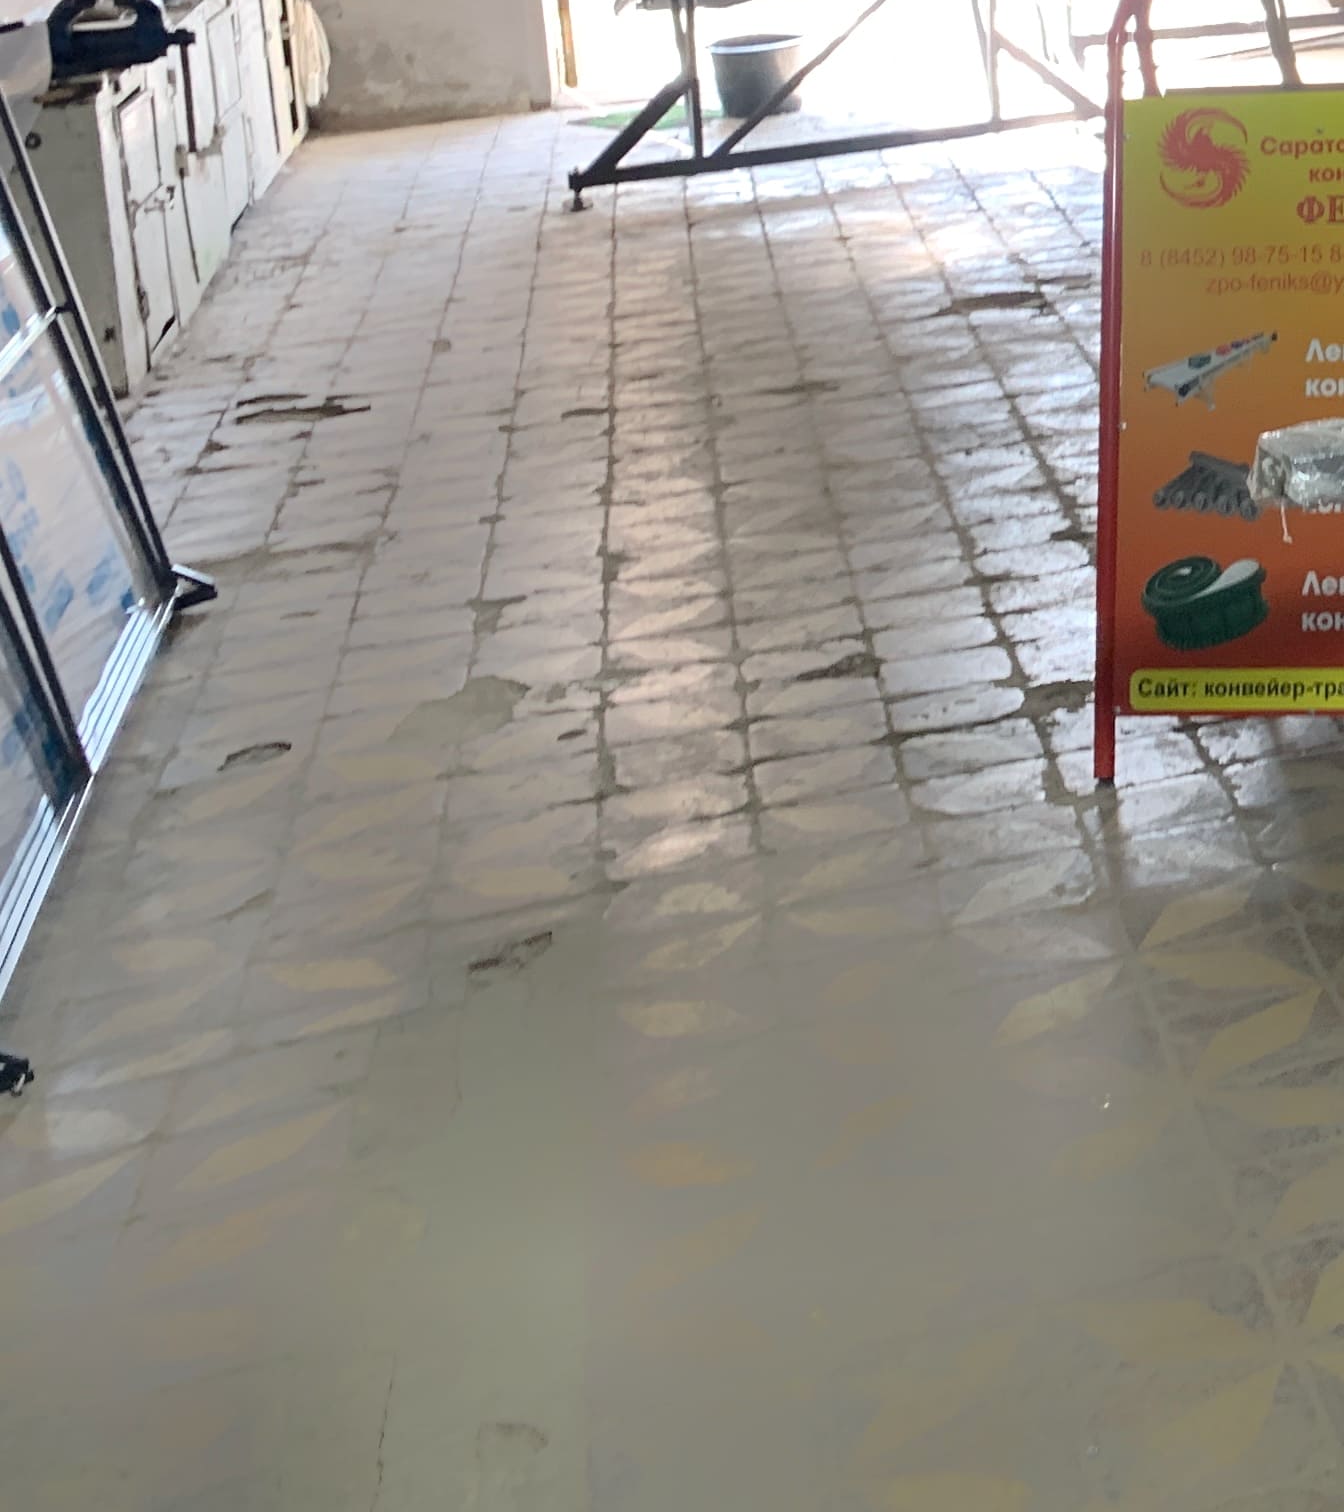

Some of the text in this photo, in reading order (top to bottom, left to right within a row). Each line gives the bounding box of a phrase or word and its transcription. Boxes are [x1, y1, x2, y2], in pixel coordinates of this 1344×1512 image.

[1140, 248, 1152, 266] 8
[1160, 247, 1225, 269] (8452)
[1232, 244, 1323, 266] 98-75-15
[1138, 677, 1197, 698] Сайт:
